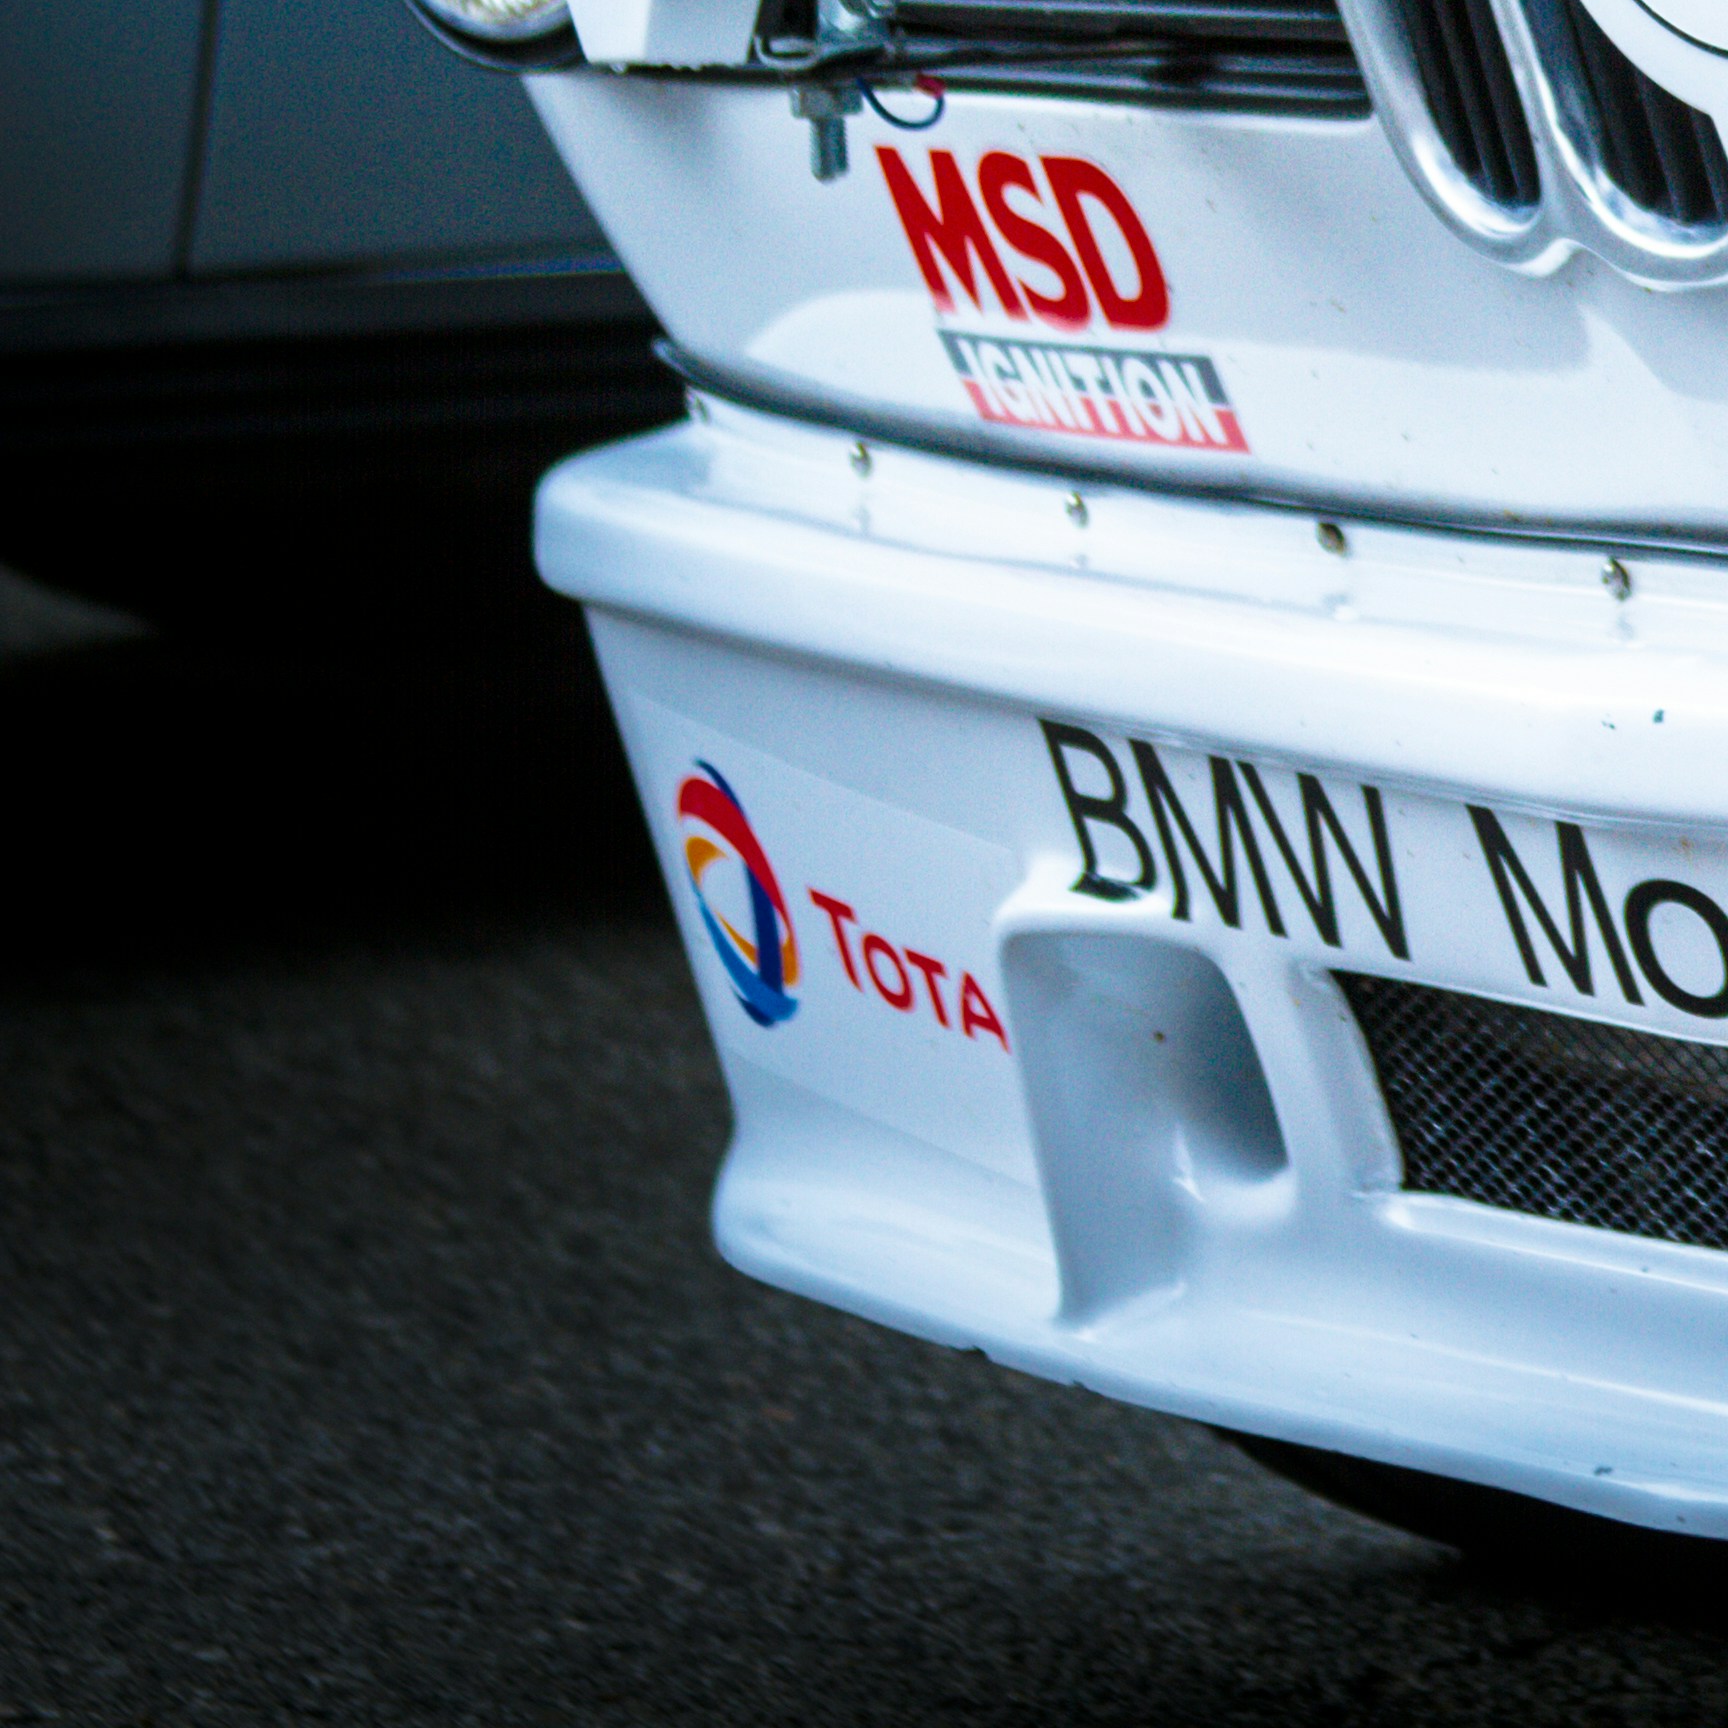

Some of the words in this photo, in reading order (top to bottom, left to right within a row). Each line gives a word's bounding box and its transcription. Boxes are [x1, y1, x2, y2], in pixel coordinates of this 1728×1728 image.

[873, 145, 1171, 333] MSD
[955, 335, 1229, 446] IGNITION
[1036, 718, 1412, 960] BMW
[807, 887, 1011, 1052] TOTA
